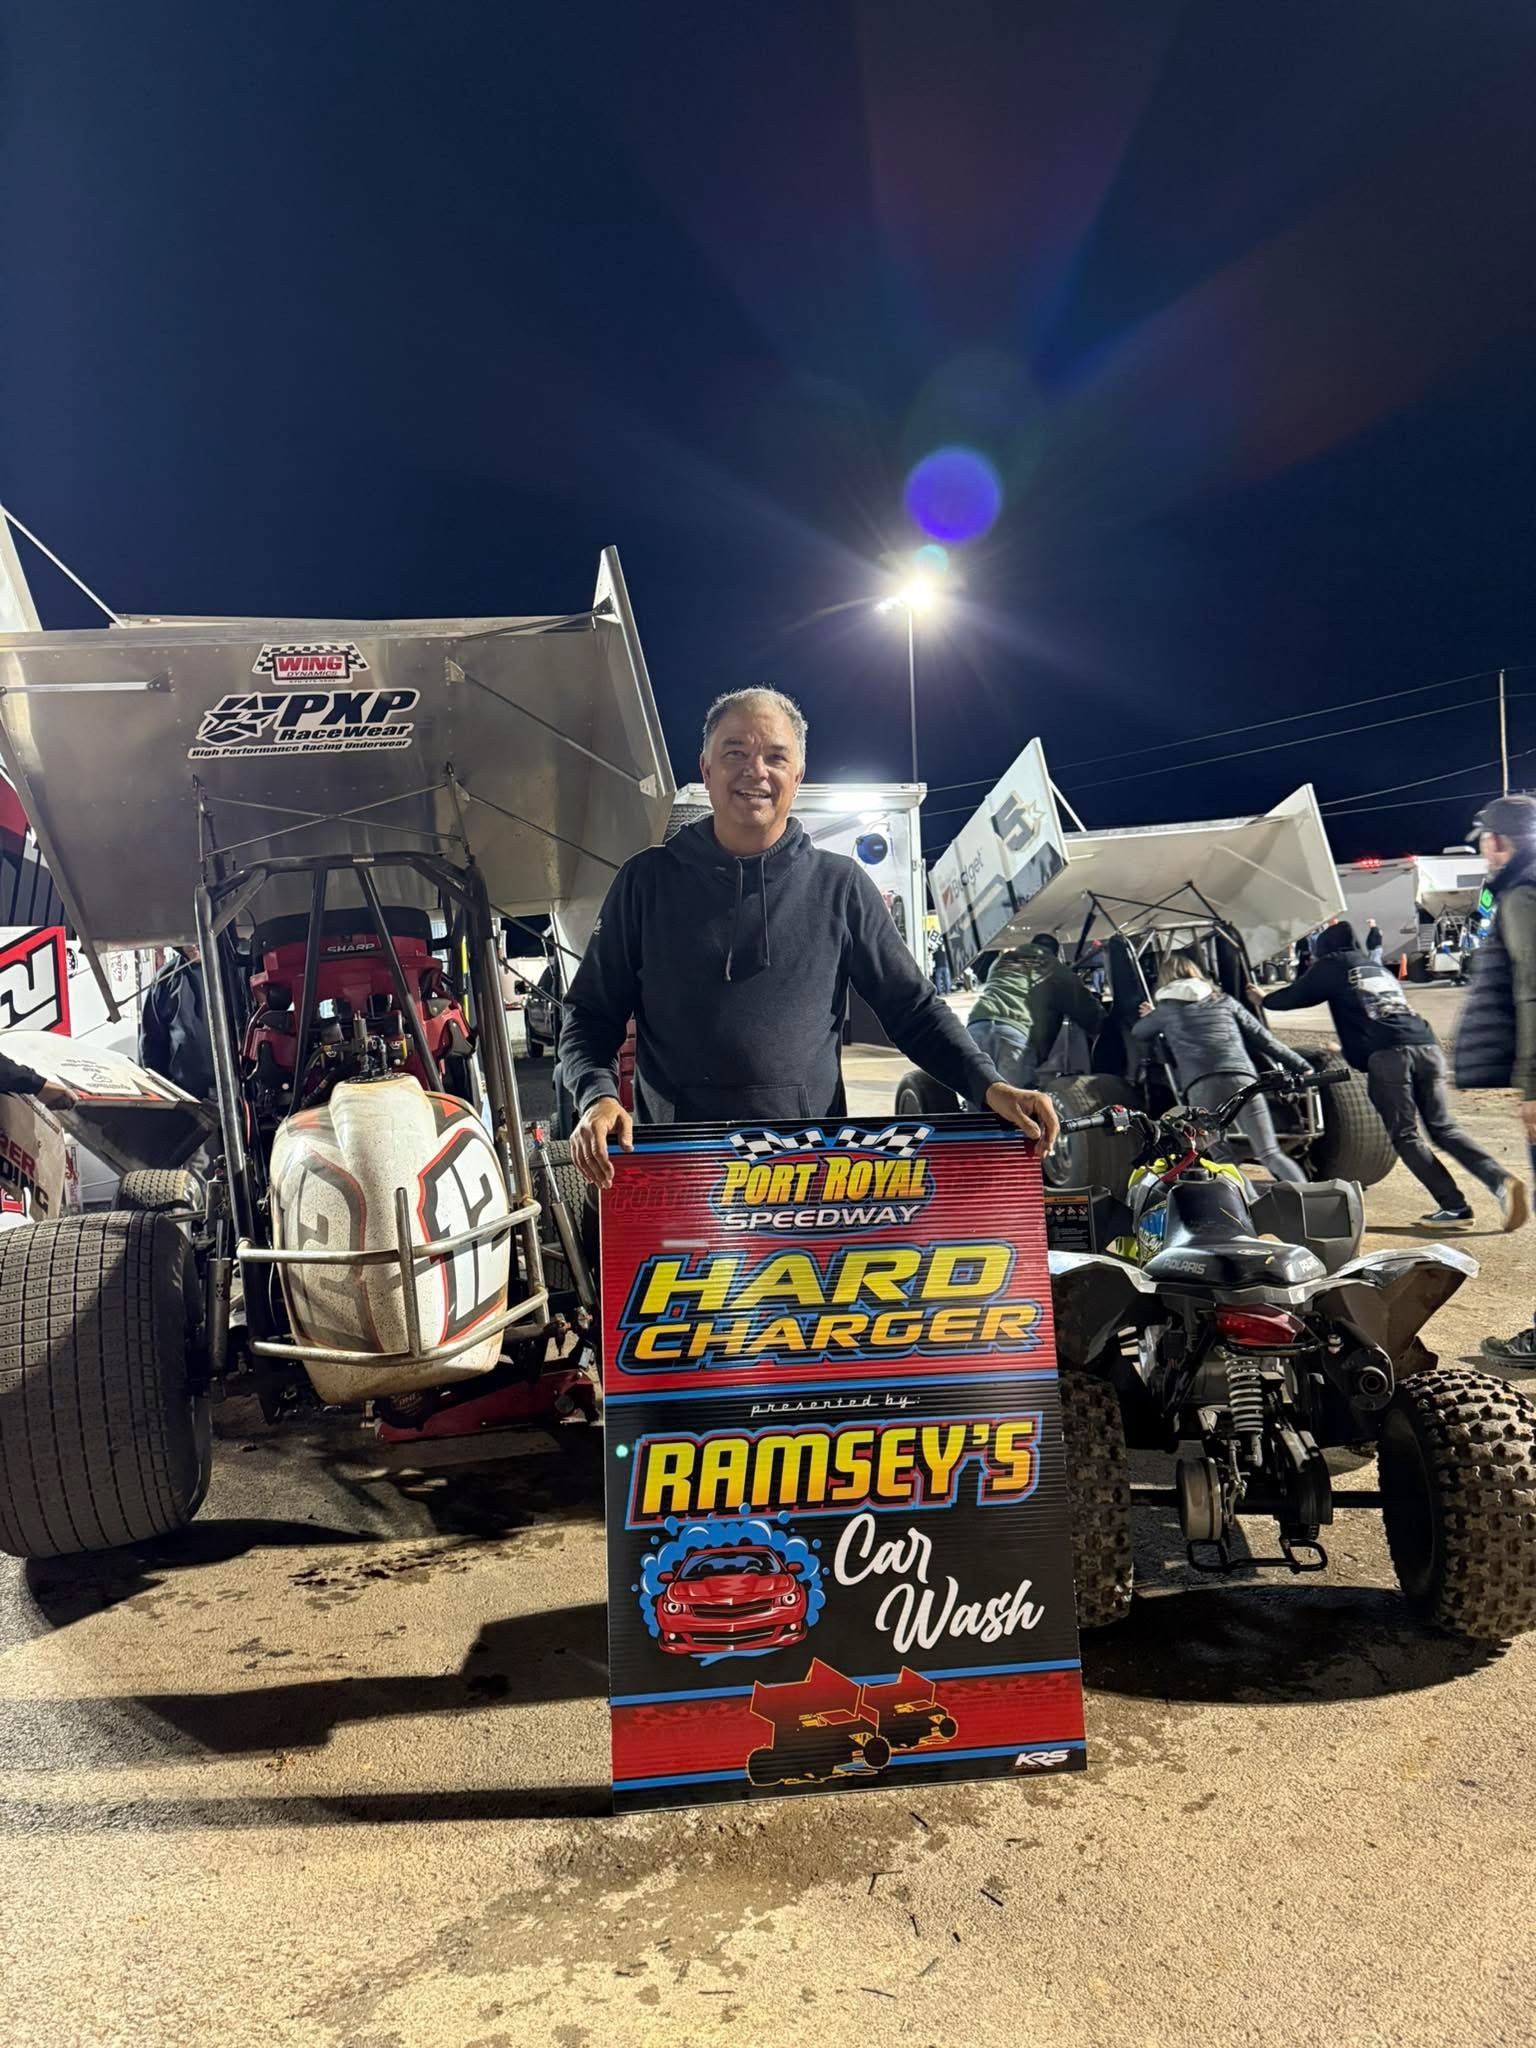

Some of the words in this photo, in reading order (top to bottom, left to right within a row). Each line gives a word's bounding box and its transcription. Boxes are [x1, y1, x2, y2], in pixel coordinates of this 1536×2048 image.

[277, 656, 343, 671] WING
[287, 670, 337, 678] DYNAMICS
[278, 691, 417, 727] PXP
[279, 724, 410, 741] RaceWear
[191, 749, 219, 758] High
[222, 745, 299, 756] Performance
[302, 742, 341, 752] Racing
[345, 740, 408, 750] Underwear
[327, 943, 376, 953] SHARP
[721, 1160, 818, 1207] PORT
[822, 1156, 927, 1201] ROYAL
[435, 1137, 510, 1321] 12
[723, 1204, 921, 1231] SPEEDWAY
[640, 1245, 1012, 1314] HARD
[1162, 1259, 1207, 1275] POLARIS
[635, 1304, 1038, 1360] CHARGER
[750, 1394, 879, 1418] presented
[885, 1393, 921, 1409] by:
[642, 1421, 1033, 1514] RAMSEY'S
[834, 1513, 933, 1586] Car
[875, 1575, 1045, 1654] Wash
[1015, 1749, 1070, 1767] KRS
